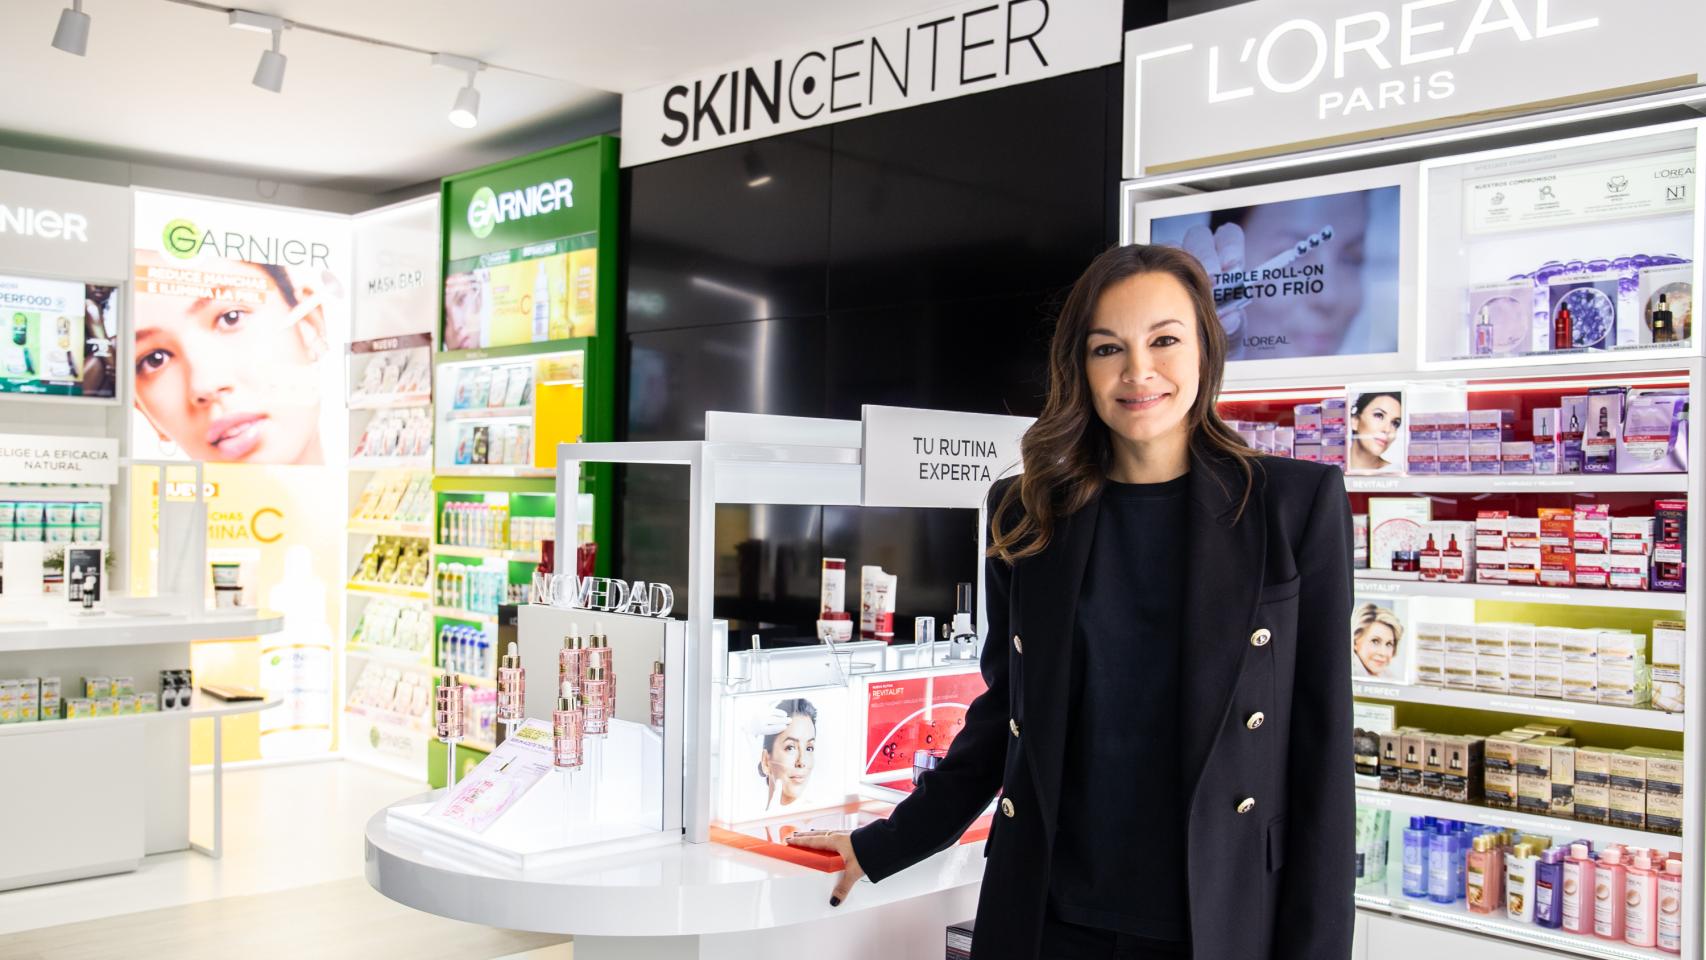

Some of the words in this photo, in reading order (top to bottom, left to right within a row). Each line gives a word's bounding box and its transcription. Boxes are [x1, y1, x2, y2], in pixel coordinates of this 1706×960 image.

[1214, 270, 1259, 286] TRIPLE
[1262, 264, 1325, 281] ROLL-ON
[1213, 284, 1278, 302] EFECTO
[1283, 277, 1325, 296] FRÍO
[34, 448, 50, 458] LA
[54, 449, 109, 460] EFICACIA
[913, 437, 934, 454] TU
[939, 439, 997, 458] RUTINA
[24, 460, 82, 471] NATURAL
[919, 463, 991, 481] EXPERTA
[532, 571, 674, 618] NOVEDAD
[872, 687, 905, 697] REVITALIFT
